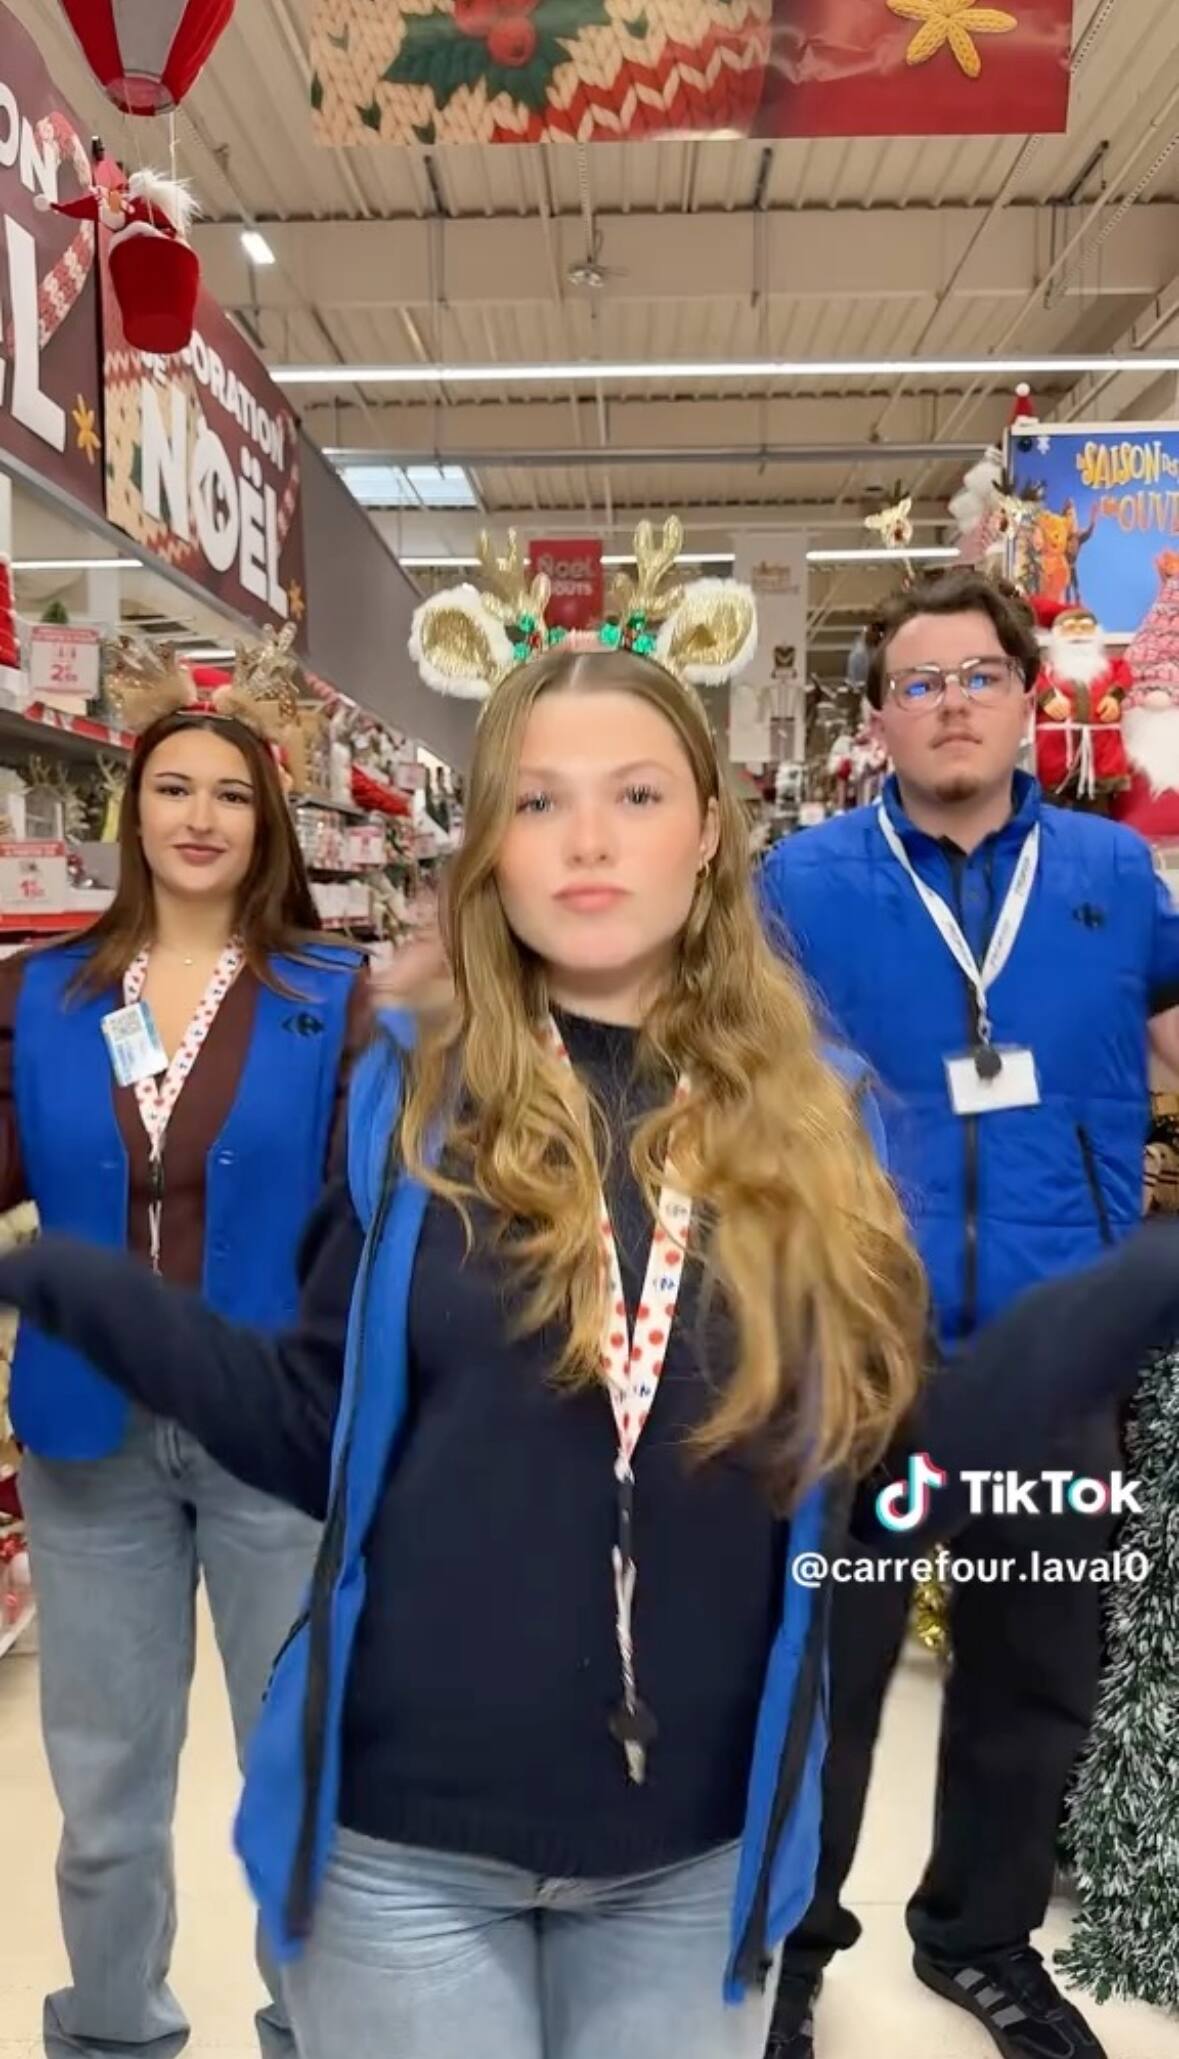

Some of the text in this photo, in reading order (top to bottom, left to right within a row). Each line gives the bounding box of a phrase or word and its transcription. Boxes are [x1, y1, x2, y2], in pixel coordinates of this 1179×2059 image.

[181, 328, 286, 471] ORATION
[1081, 441, 1162, 490] SAISON
[140, 375, 289, 619] NOËL
